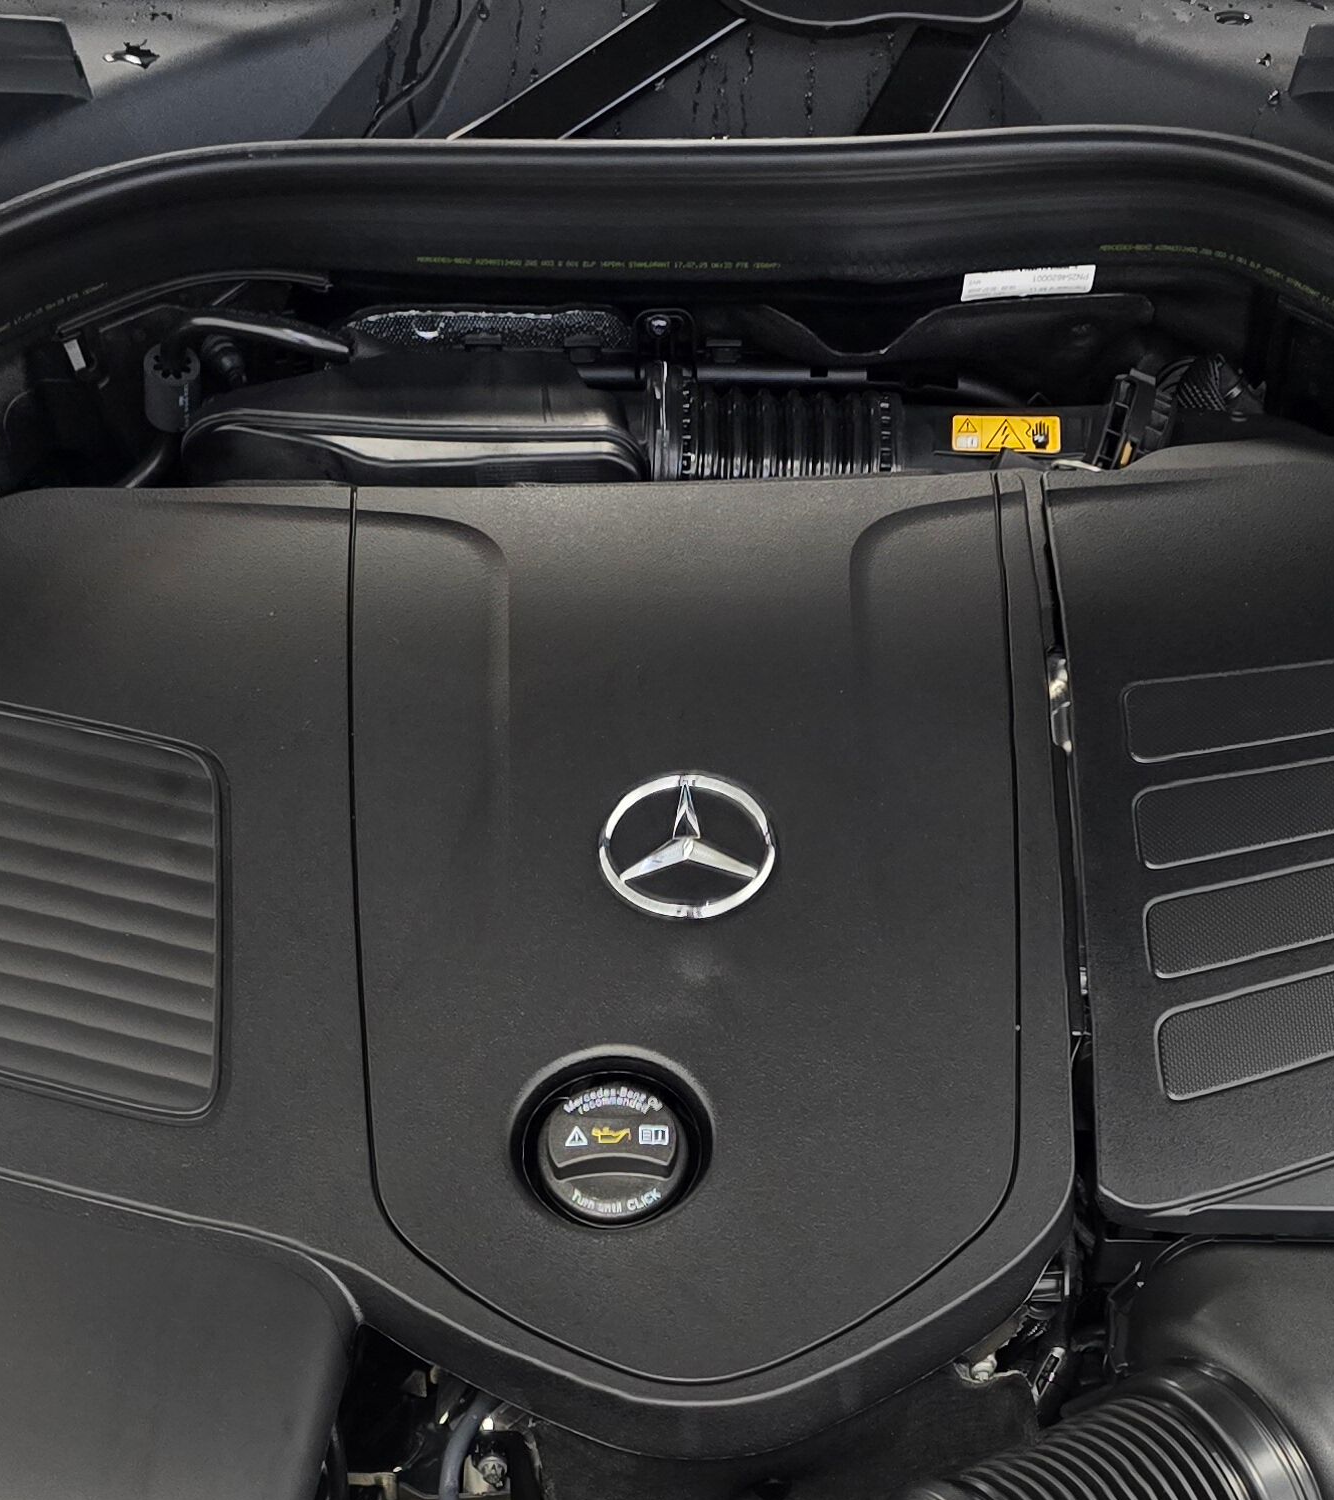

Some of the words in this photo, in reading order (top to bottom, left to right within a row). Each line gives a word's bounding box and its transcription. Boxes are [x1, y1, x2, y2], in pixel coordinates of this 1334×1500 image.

[563, 1086, 647, 1114] Mercedes-Benz
[578, 1096, 650, 1115] recommended
[571, 1188, 596, 1210] Turn
[596, 1200, 623, 1213] until
[627, 1187, 663, 1212] CLICK
